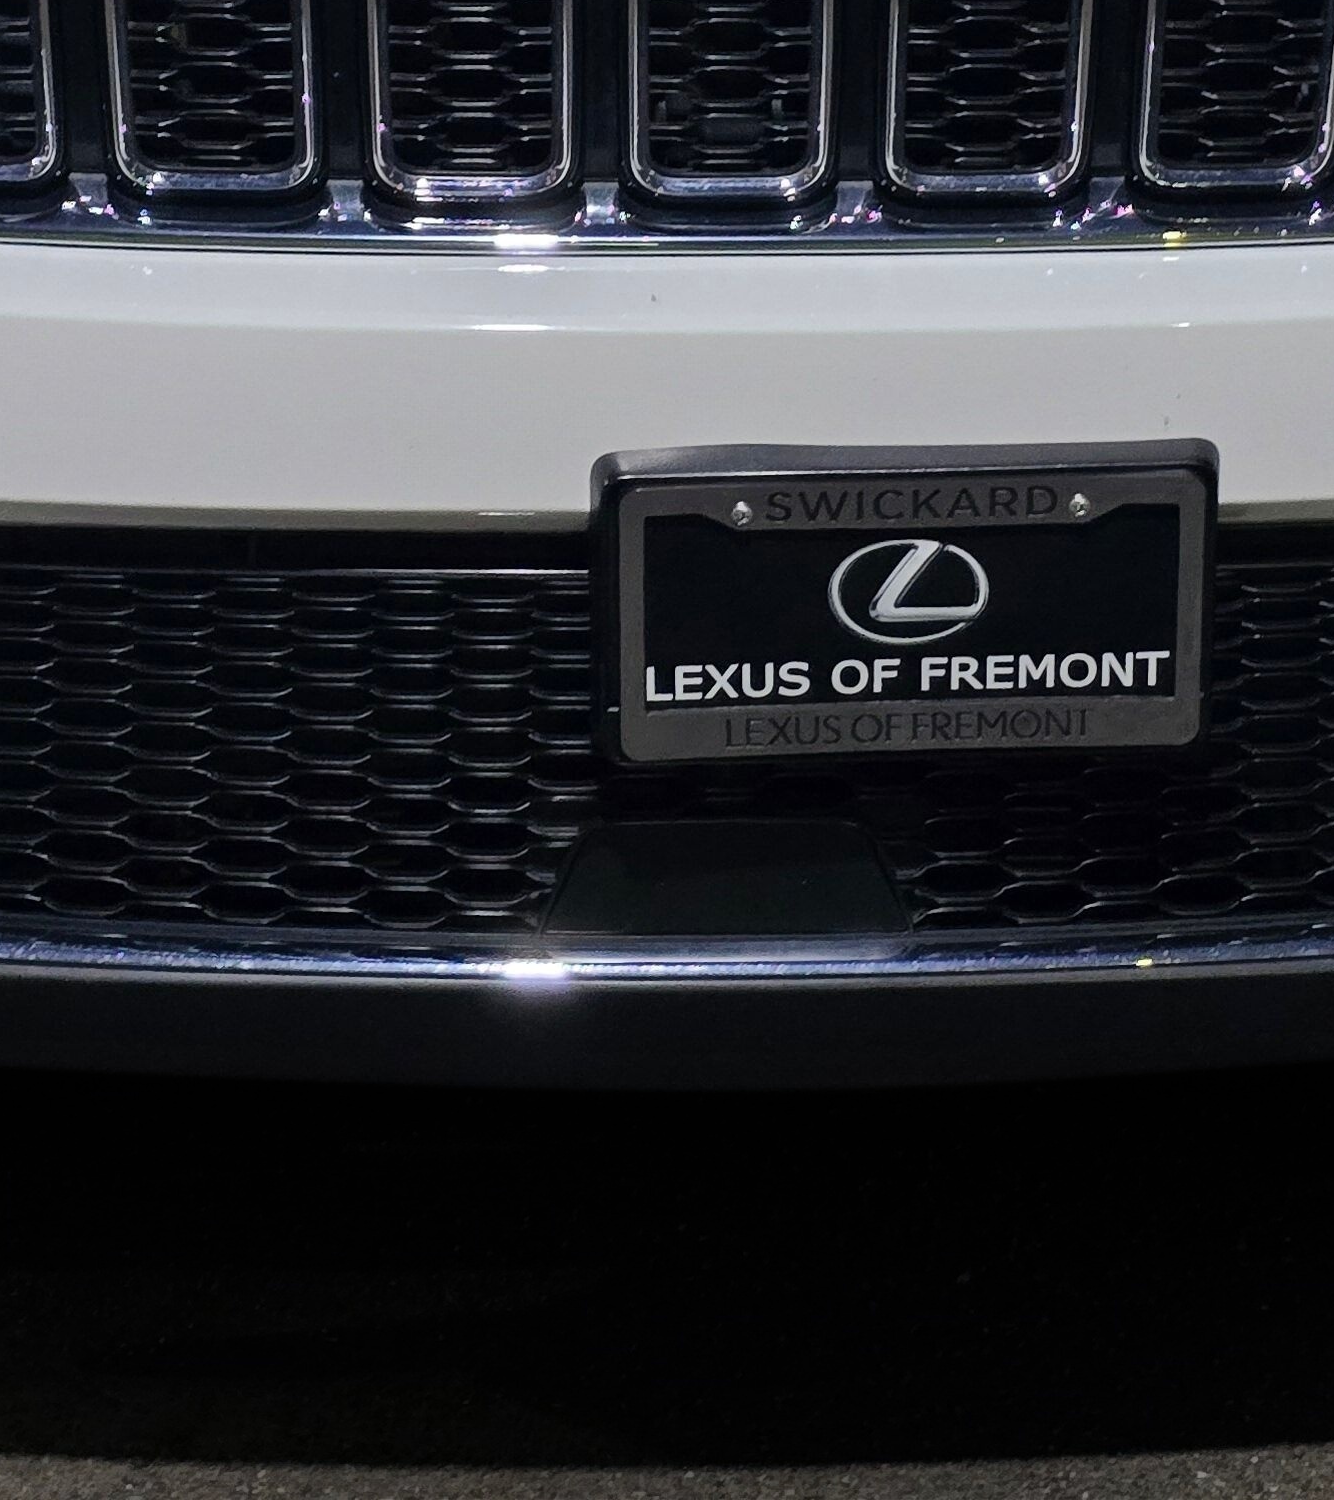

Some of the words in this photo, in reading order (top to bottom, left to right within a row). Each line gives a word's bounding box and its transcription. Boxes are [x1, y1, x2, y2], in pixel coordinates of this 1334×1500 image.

[766, 484, 1059, 524] SWICKARD
[645, 660, 811, 702] LEXUS
[831, 658, 901, 694] OF
[920, 649, 1171, 693] FREMONT
[724, 711, 842, 750] LEXUS
[850, 710, 905, 743] OF
[910, 707, 1092, 742] FREMONT
